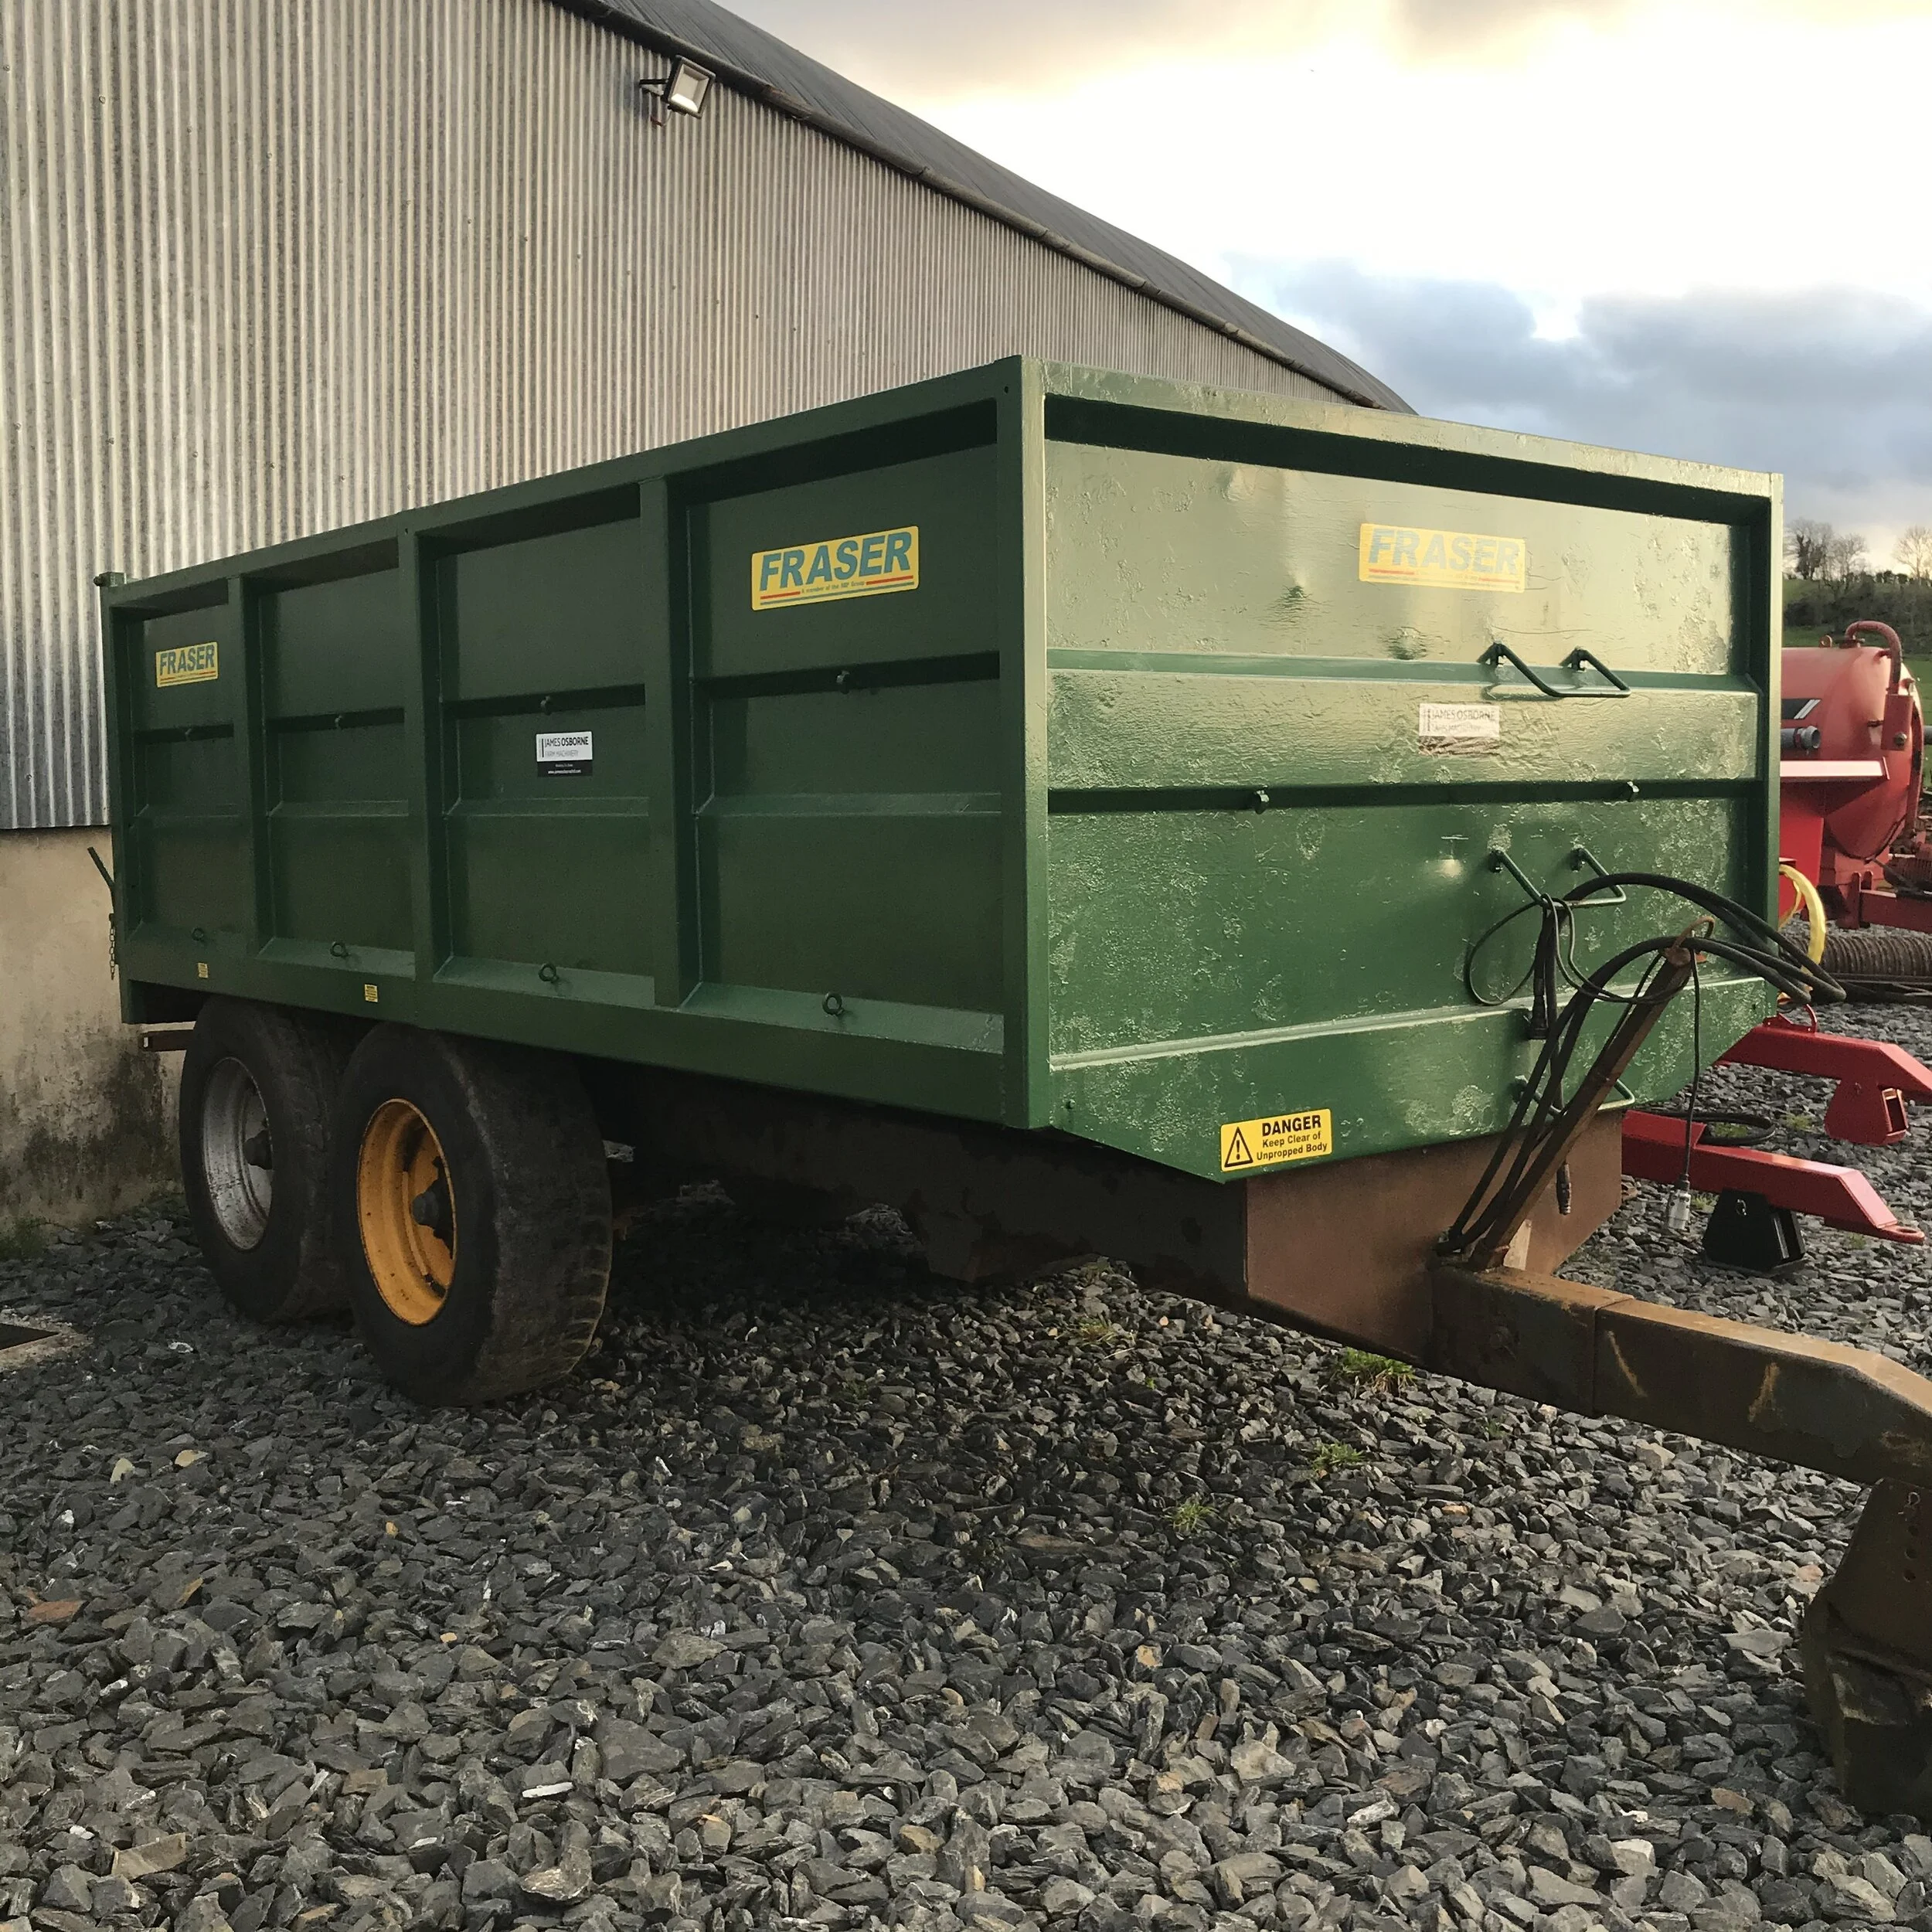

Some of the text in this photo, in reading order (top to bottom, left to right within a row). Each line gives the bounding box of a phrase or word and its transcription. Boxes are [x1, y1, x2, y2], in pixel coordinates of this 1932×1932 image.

[760, 531, 912, 591] FRASER
[1369, 528, 1520, 575] FRASER
[160, 645, 215, 676] FRASER
[1432, 709, 1496, 722] JAMES OSBORNE
[545, 736, 589, 747] JAMES OSBORNE
[1262, 1114, 1321, 1137] DANGER
[1263, 1131, 1321, 1148] Keep Clear of
[1257, 1142, 1328, 1161] Unpropped Body
